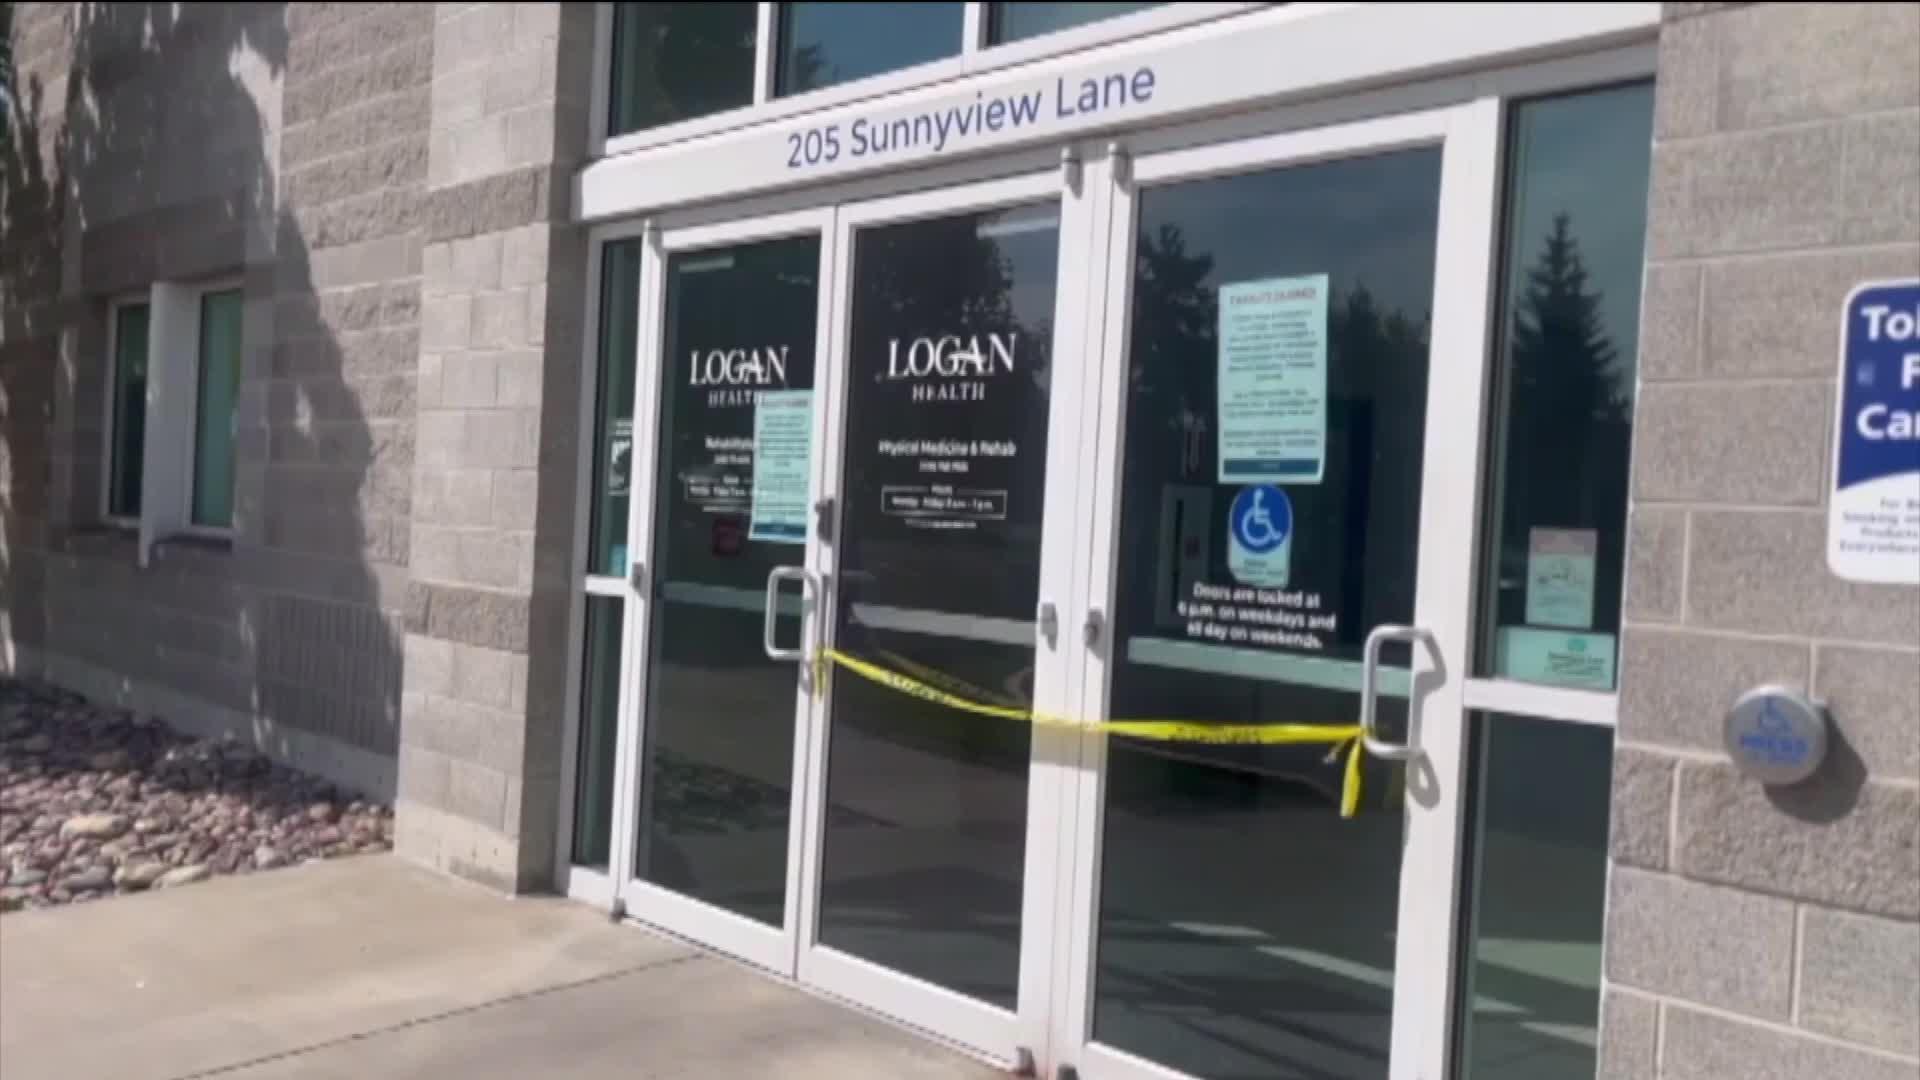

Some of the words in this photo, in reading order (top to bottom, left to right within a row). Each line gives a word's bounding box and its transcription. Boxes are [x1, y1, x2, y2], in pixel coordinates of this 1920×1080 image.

[786, 125, 840, 169] 205
[850, 89, 1042, 157] Sunnyview
[1055, 67, 1155, 119] Lane
[689, 345, 788, 385] LOGAN
[888, 333, 1016, 378] LOGAN
[912, 382, 985, 402] HEALTH
[1193, 582, 1231, 601] Doors
[1233, 590, 1255, 603] are
[1257, 589, 1303, 608] locked
[1305, 594, 1320, 608] at
[1204, 623, 1228, 640] day
[1229, 626, 1248, 640] on
[1218, 606, 1236, 620] on
[1238, 607, 1305, 629] weekdays
[1307, 613, 1336, 631] and
